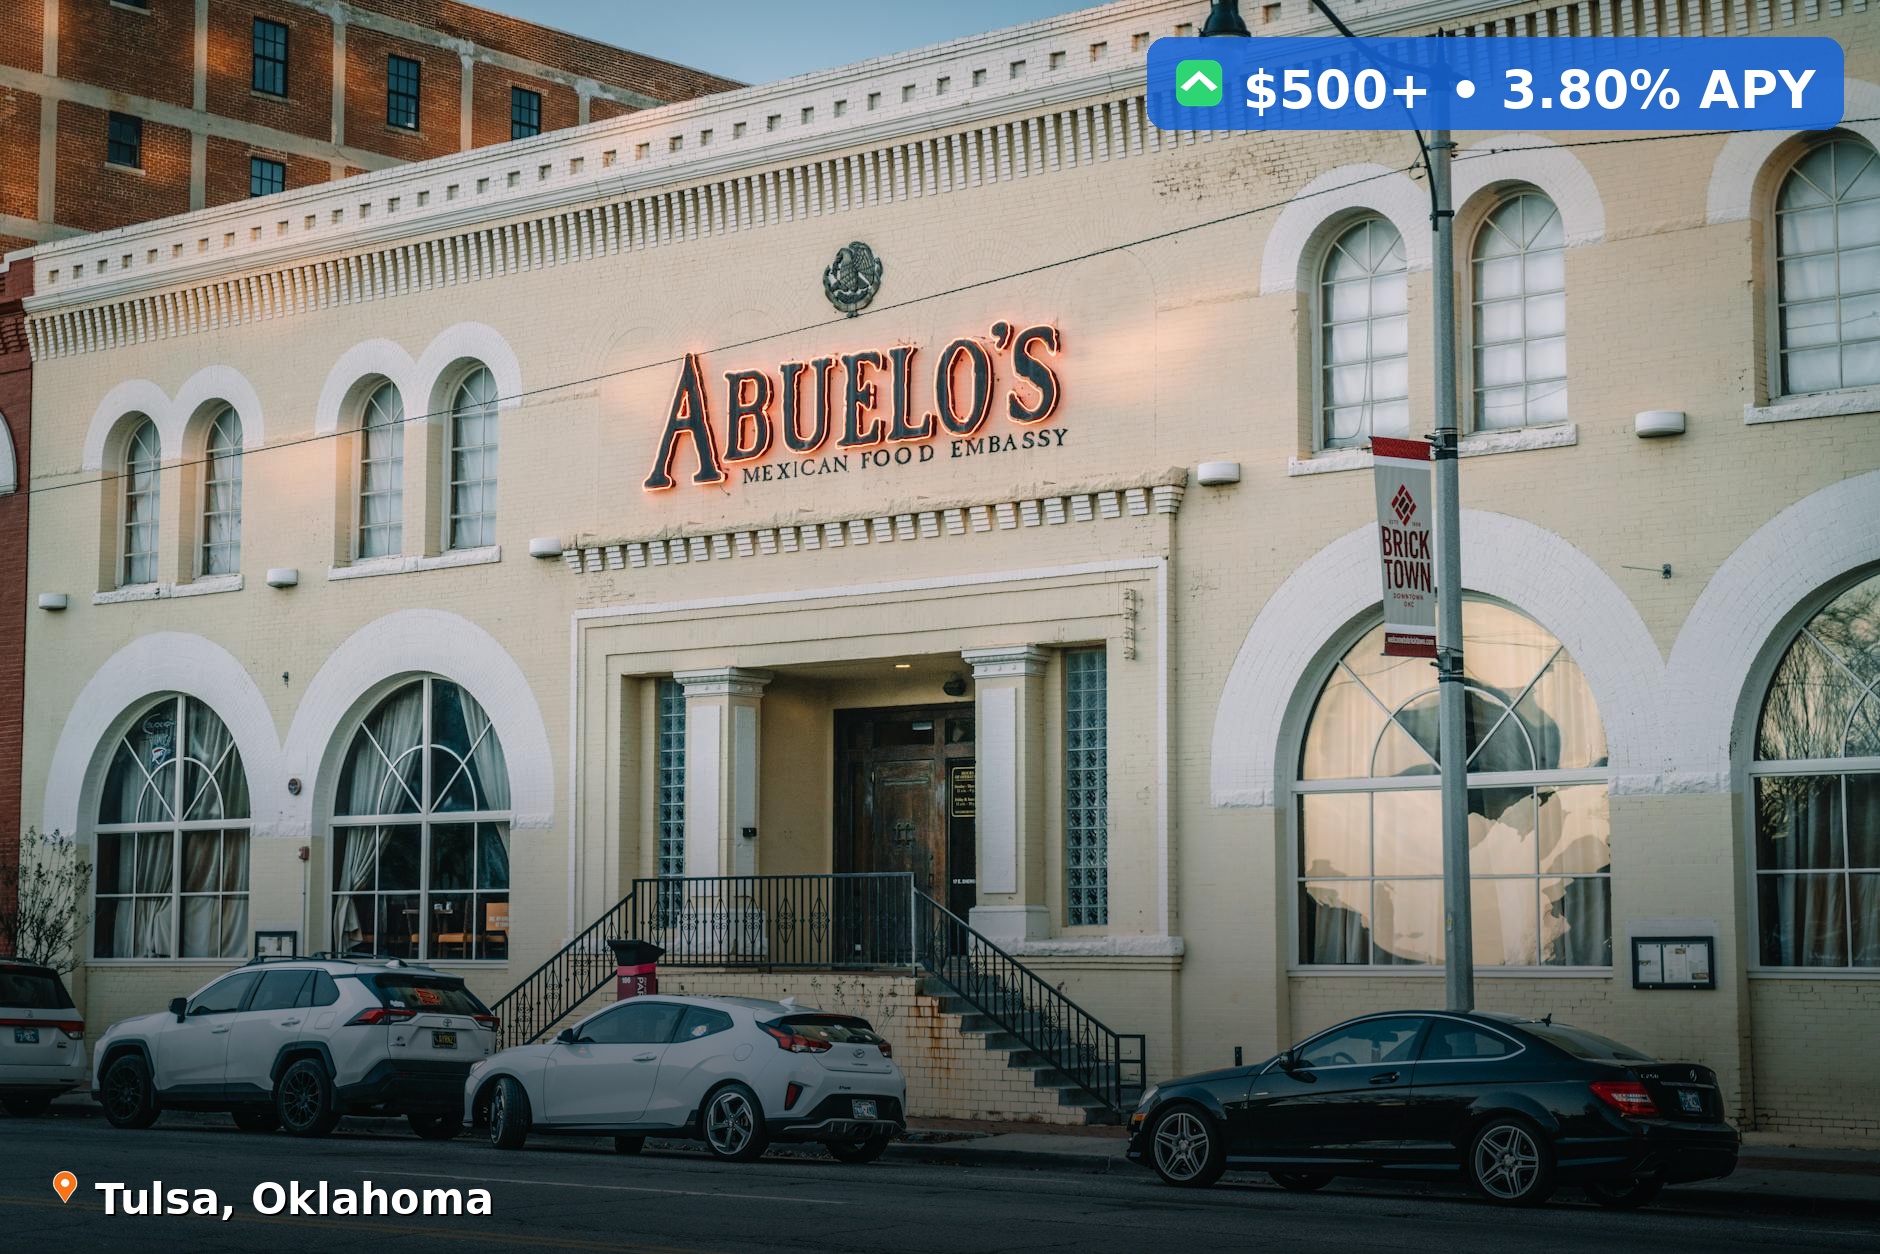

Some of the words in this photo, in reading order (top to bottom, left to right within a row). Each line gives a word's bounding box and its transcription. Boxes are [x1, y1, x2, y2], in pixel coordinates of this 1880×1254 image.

[742, 455, 849, 484] MEXICAN
[860, 444, 935, 470] FOOD
[950, 428, 1068, 459] EMBASSY
[1381, 525, 1431, 560] BRICK
[1383, 558, 1432, 593] TOWN
[1393, 592, 1424, 601] DOWNTOWN
